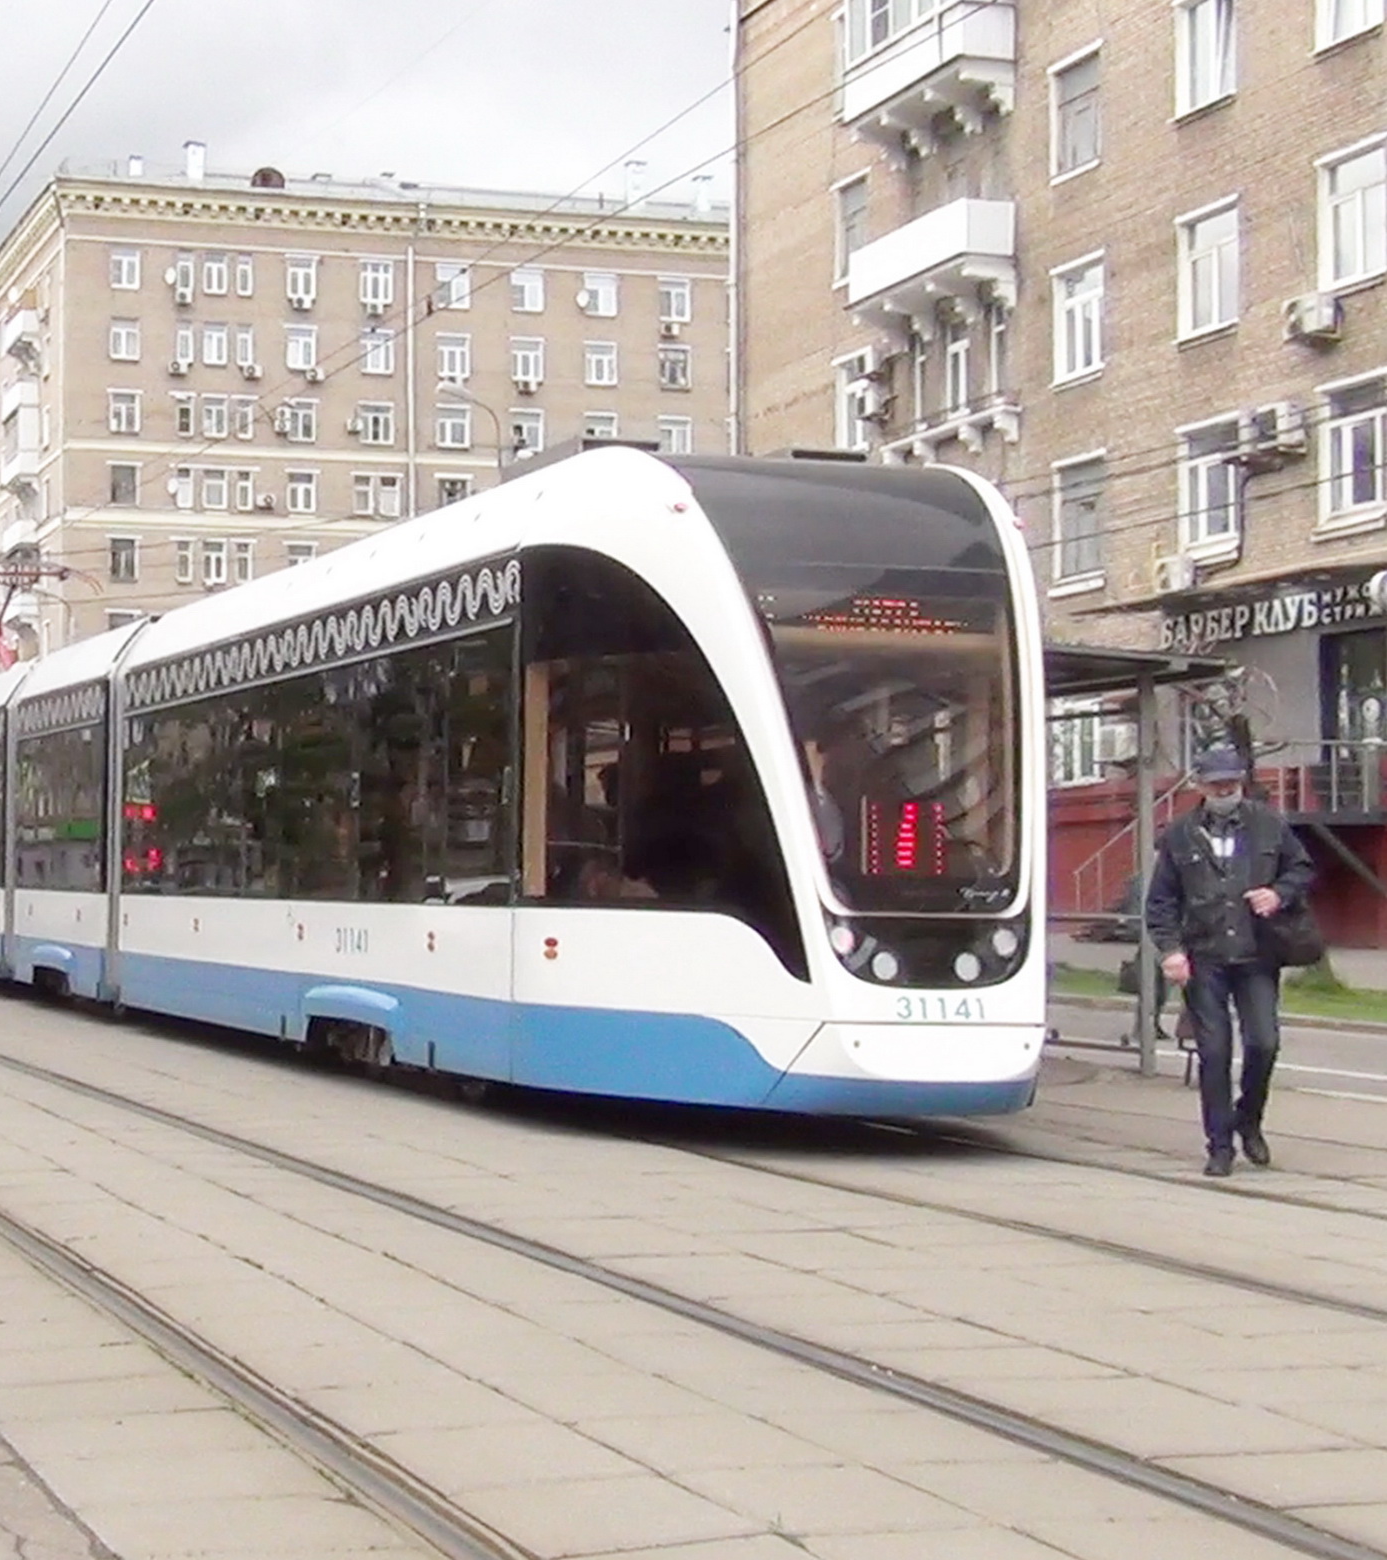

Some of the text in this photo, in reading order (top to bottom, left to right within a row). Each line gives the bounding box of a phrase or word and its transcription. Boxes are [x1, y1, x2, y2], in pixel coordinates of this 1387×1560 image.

[1159, 592, 1318, 652] БАРБЕР КЛУБ
[336, 927, 368, 953] 31141
[896, 996, 985, 1019] 31141
